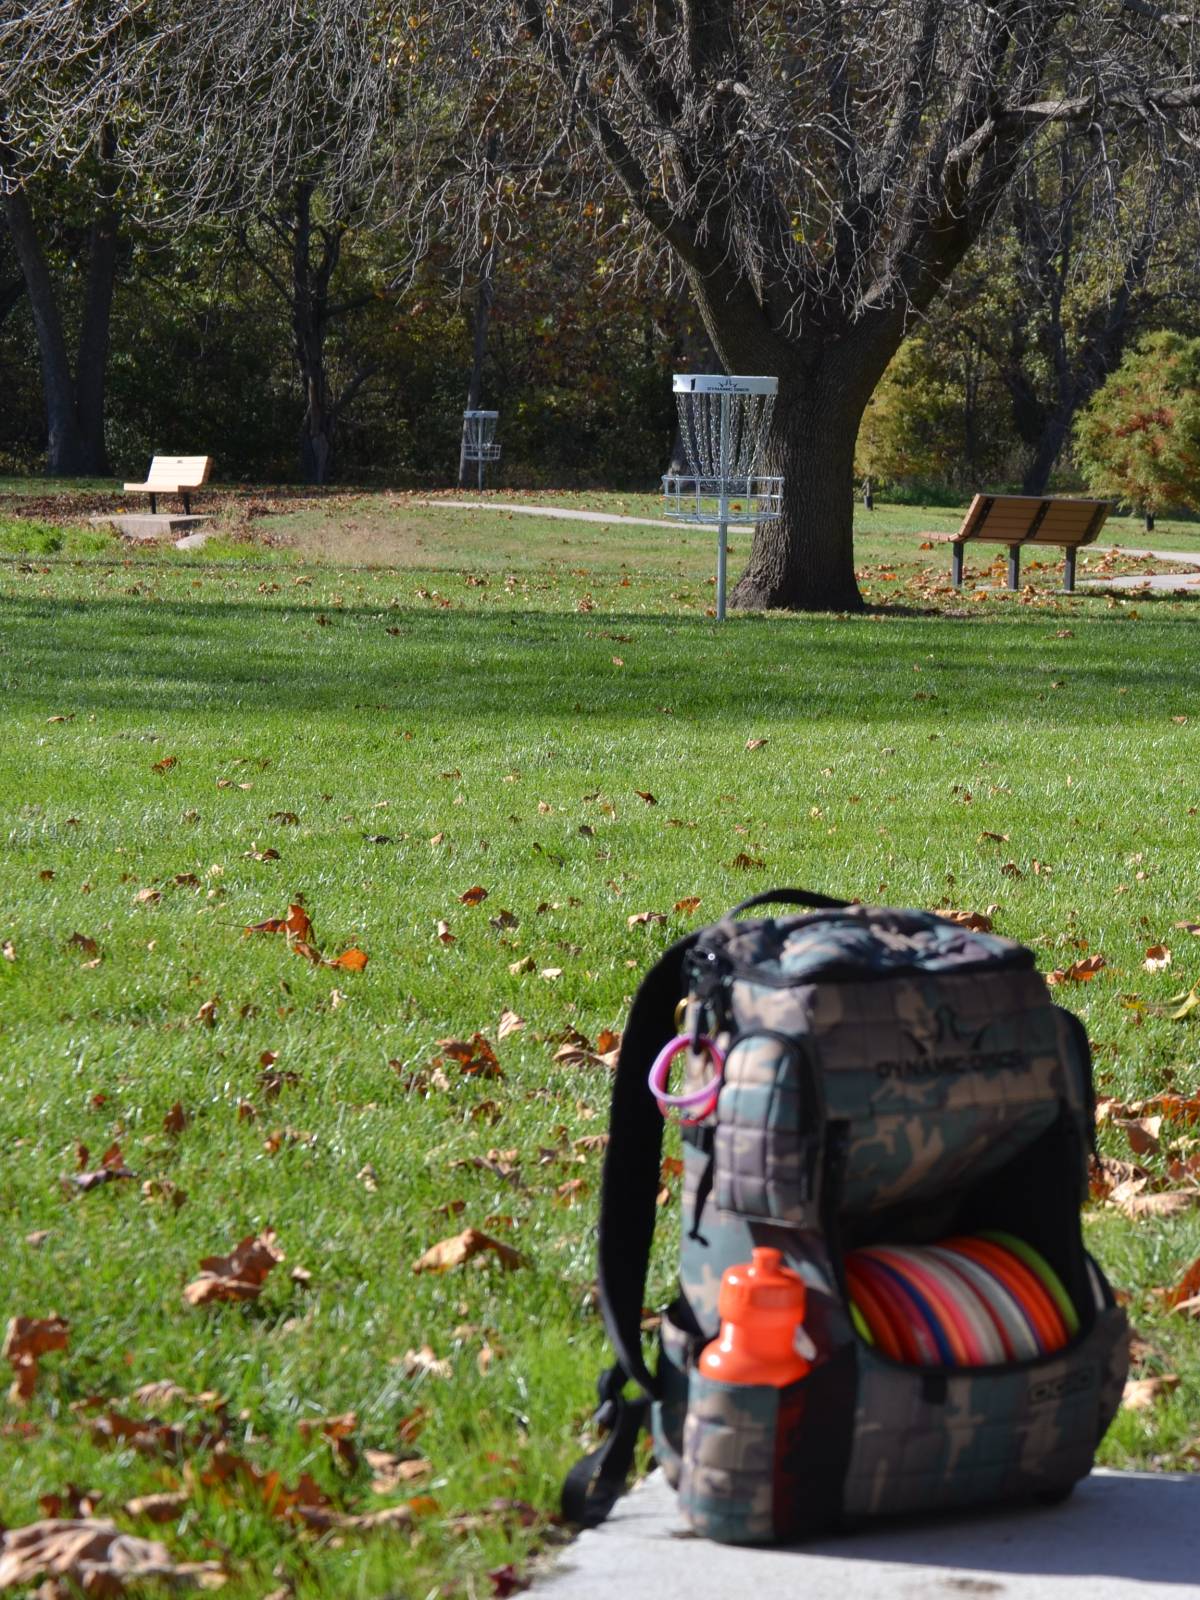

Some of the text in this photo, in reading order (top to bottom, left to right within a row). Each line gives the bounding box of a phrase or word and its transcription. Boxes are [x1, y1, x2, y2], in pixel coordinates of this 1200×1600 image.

[690, 379, 696, 390] 1
[876, 1049, 1022, 1078] DYNAMIC DISCS
